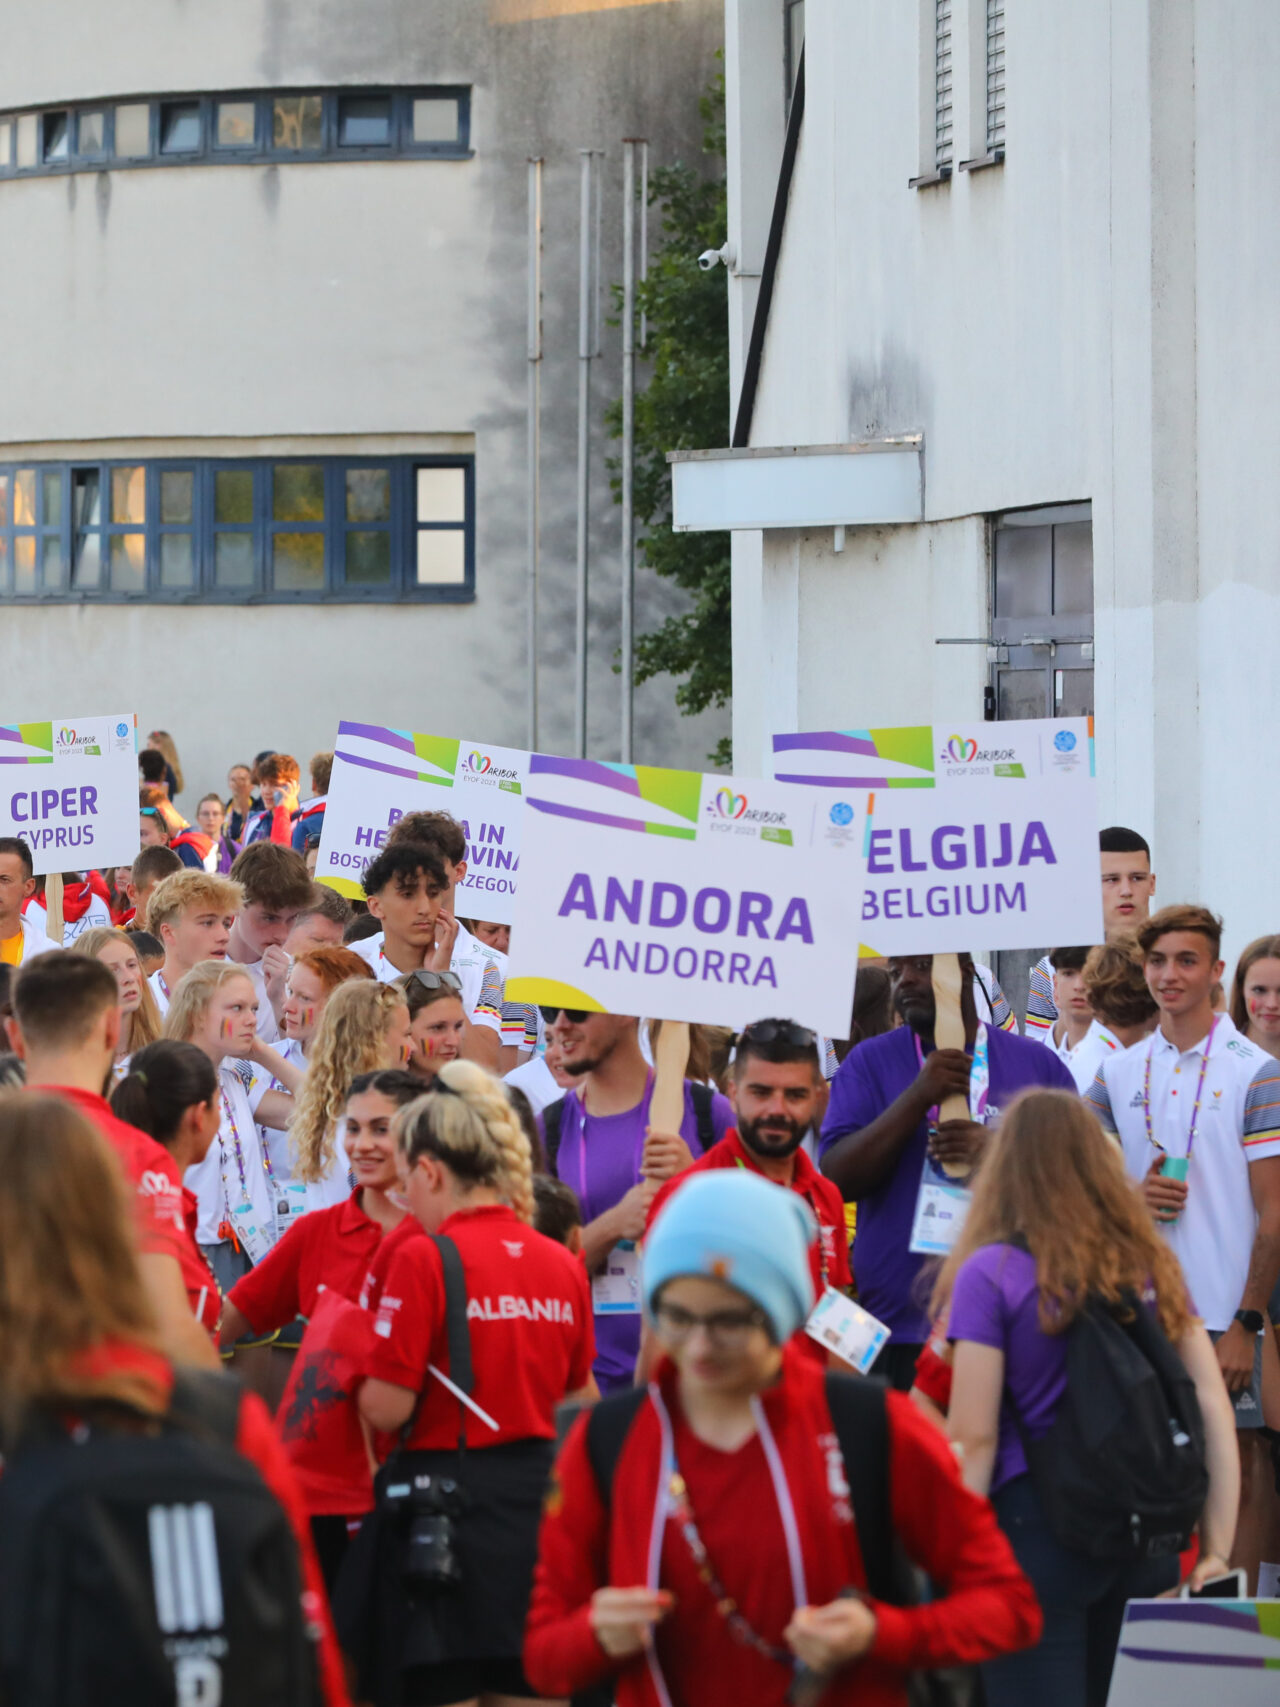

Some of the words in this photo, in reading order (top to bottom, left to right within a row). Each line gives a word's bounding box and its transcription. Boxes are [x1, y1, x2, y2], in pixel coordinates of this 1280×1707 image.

[11, 786, 98, 822] CIPER
[479, 823, 505, 845] IN
[867, 821, 1057, 873] ELGIJA
[330, 851, 372, 869] BOSN
[558, 873, 814, 945] ANDORA
[862, 882, 1026, 920] BELGIUM
[584, 937, 778, 989] ANDORRA
[466, 1295, 574, 1325] ALBANIA
